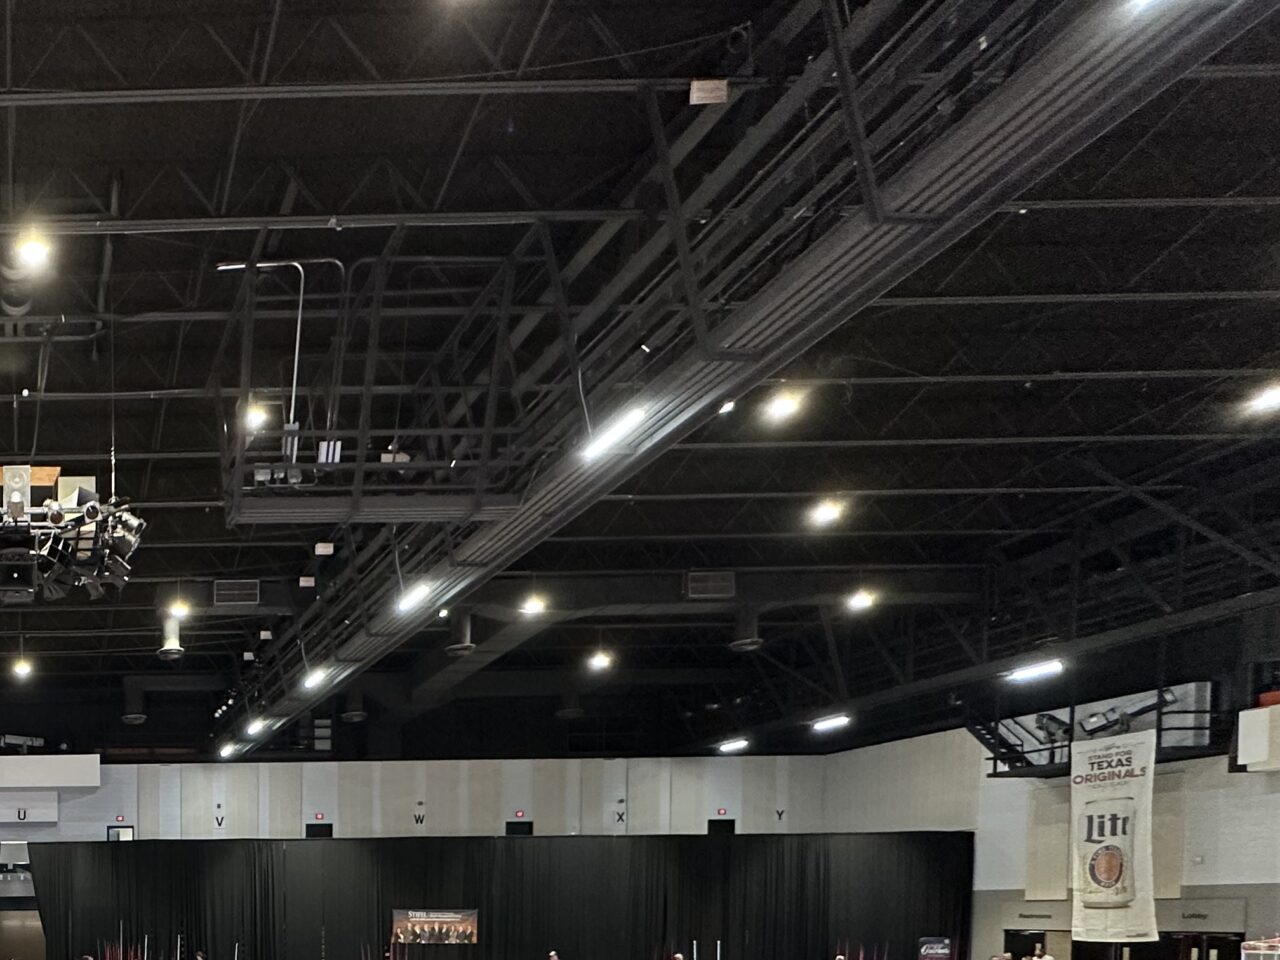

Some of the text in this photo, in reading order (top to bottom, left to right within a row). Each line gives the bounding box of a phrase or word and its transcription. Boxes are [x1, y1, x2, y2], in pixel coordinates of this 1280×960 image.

[1088, 756, 1132, 771] TEXAS
[1073, 766, 1147, 784] ORIGINALS
[17, 808, 26, 821] U
[414, 814, 425, 824] W
[616, 812, 625, 822] X
[776, 810, 784, 820] Y
[215, 816, 224, 827] V
